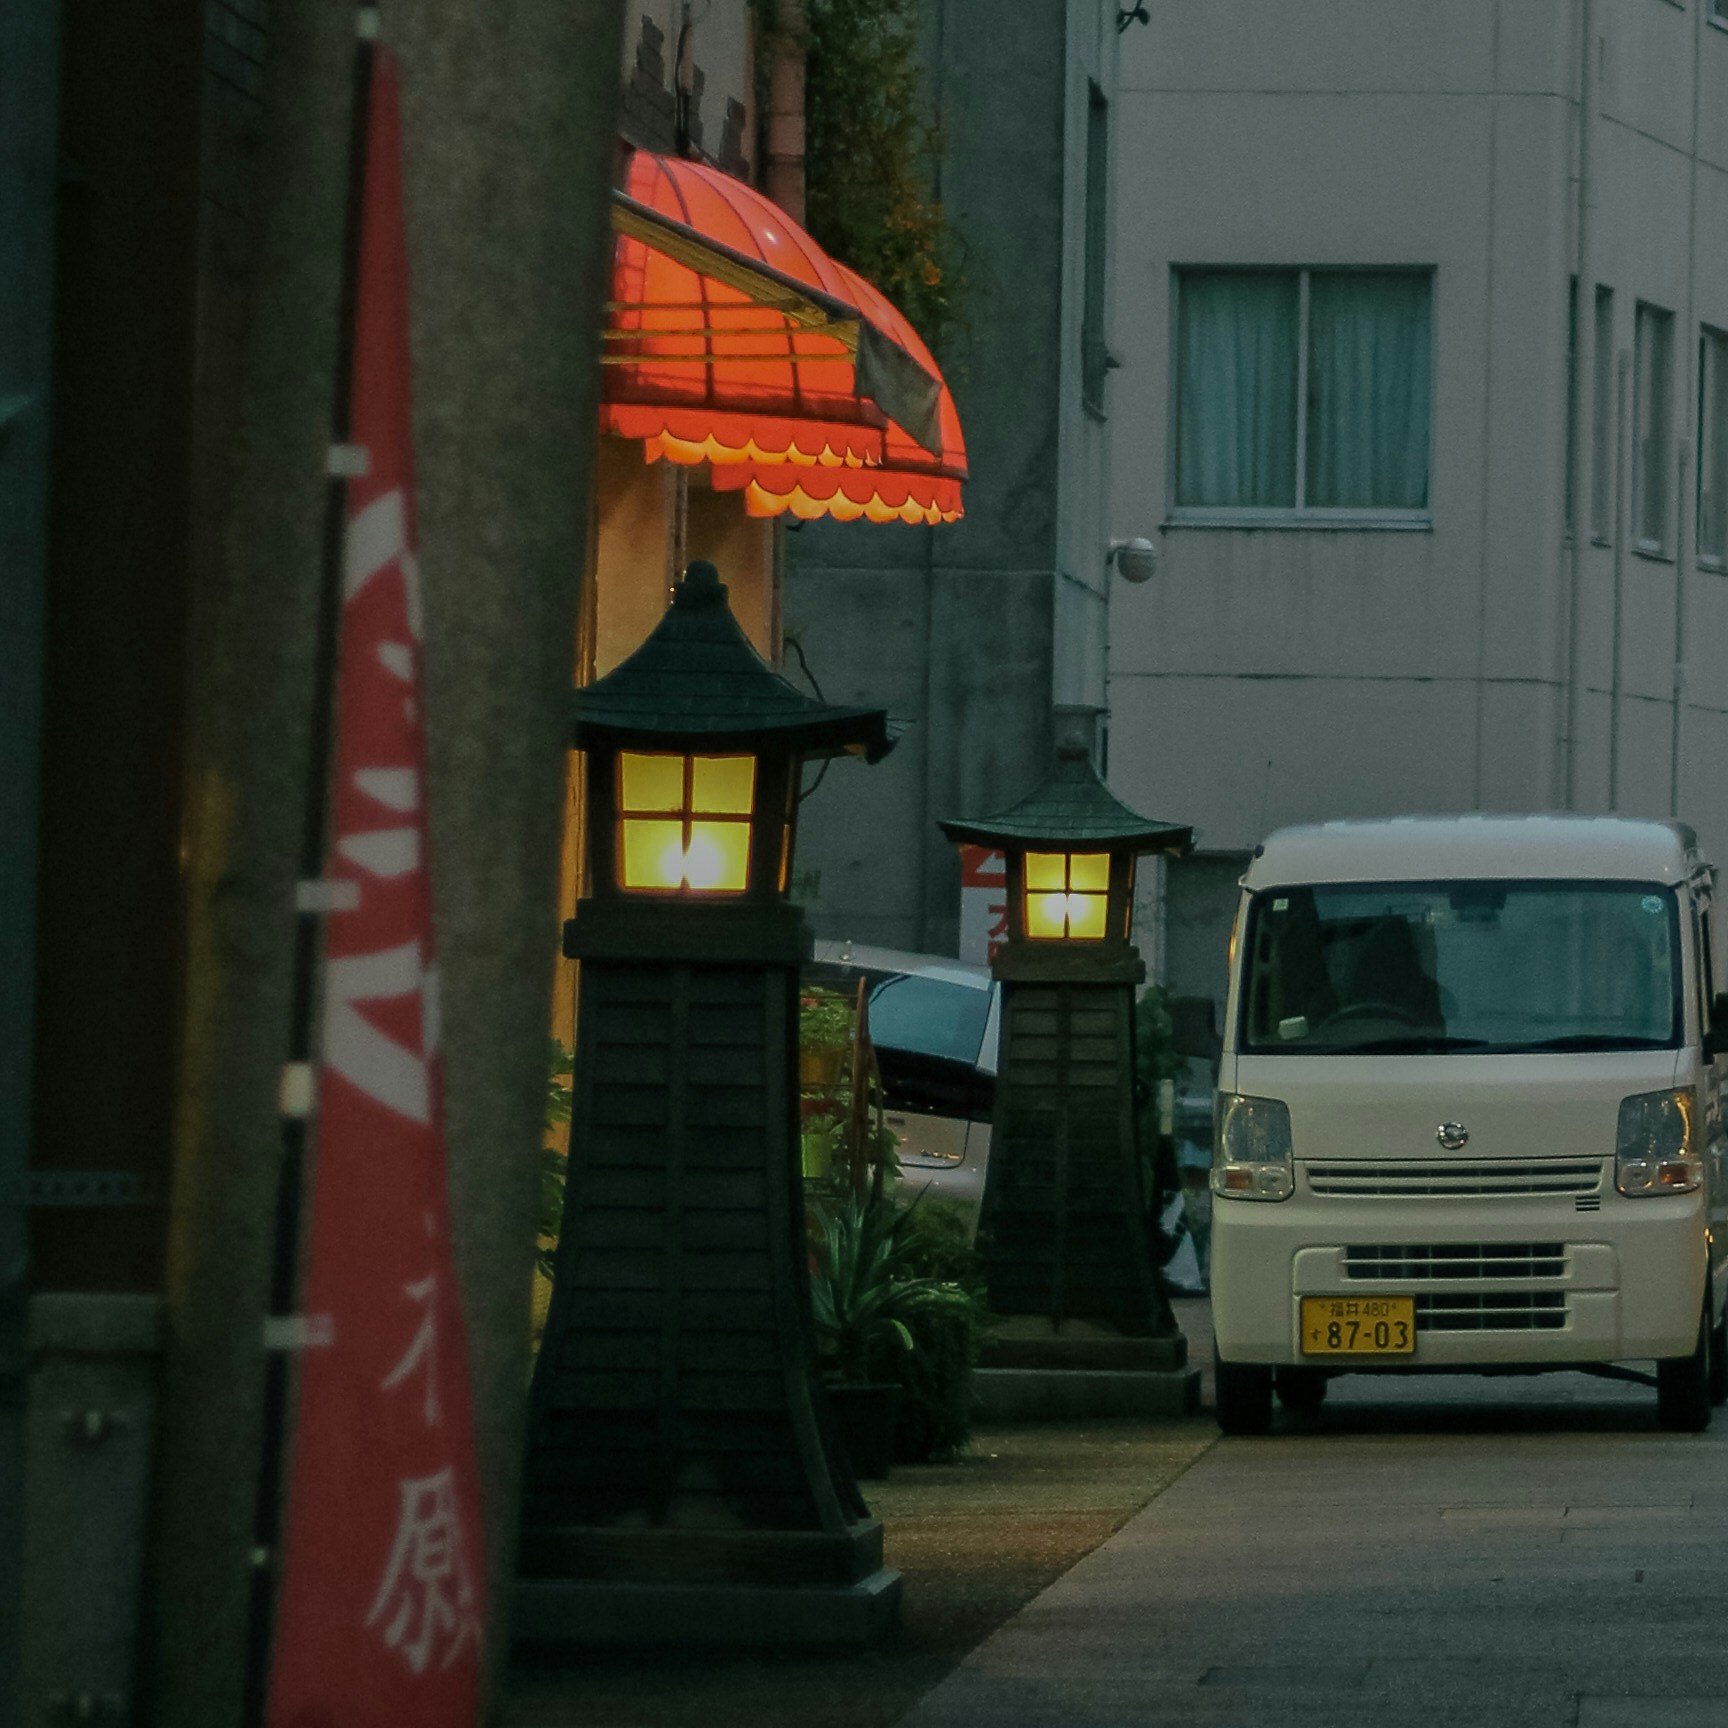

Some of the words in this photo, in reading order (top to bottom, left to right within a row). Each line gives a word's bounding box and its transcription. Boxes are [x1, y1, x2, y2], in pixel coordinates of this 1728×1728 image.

[1329, 1302, 1359, 1317] 福井
[1362, 1302, 1390, 1317] 480
[1327, 1320, 1408, 1349] 87-03
